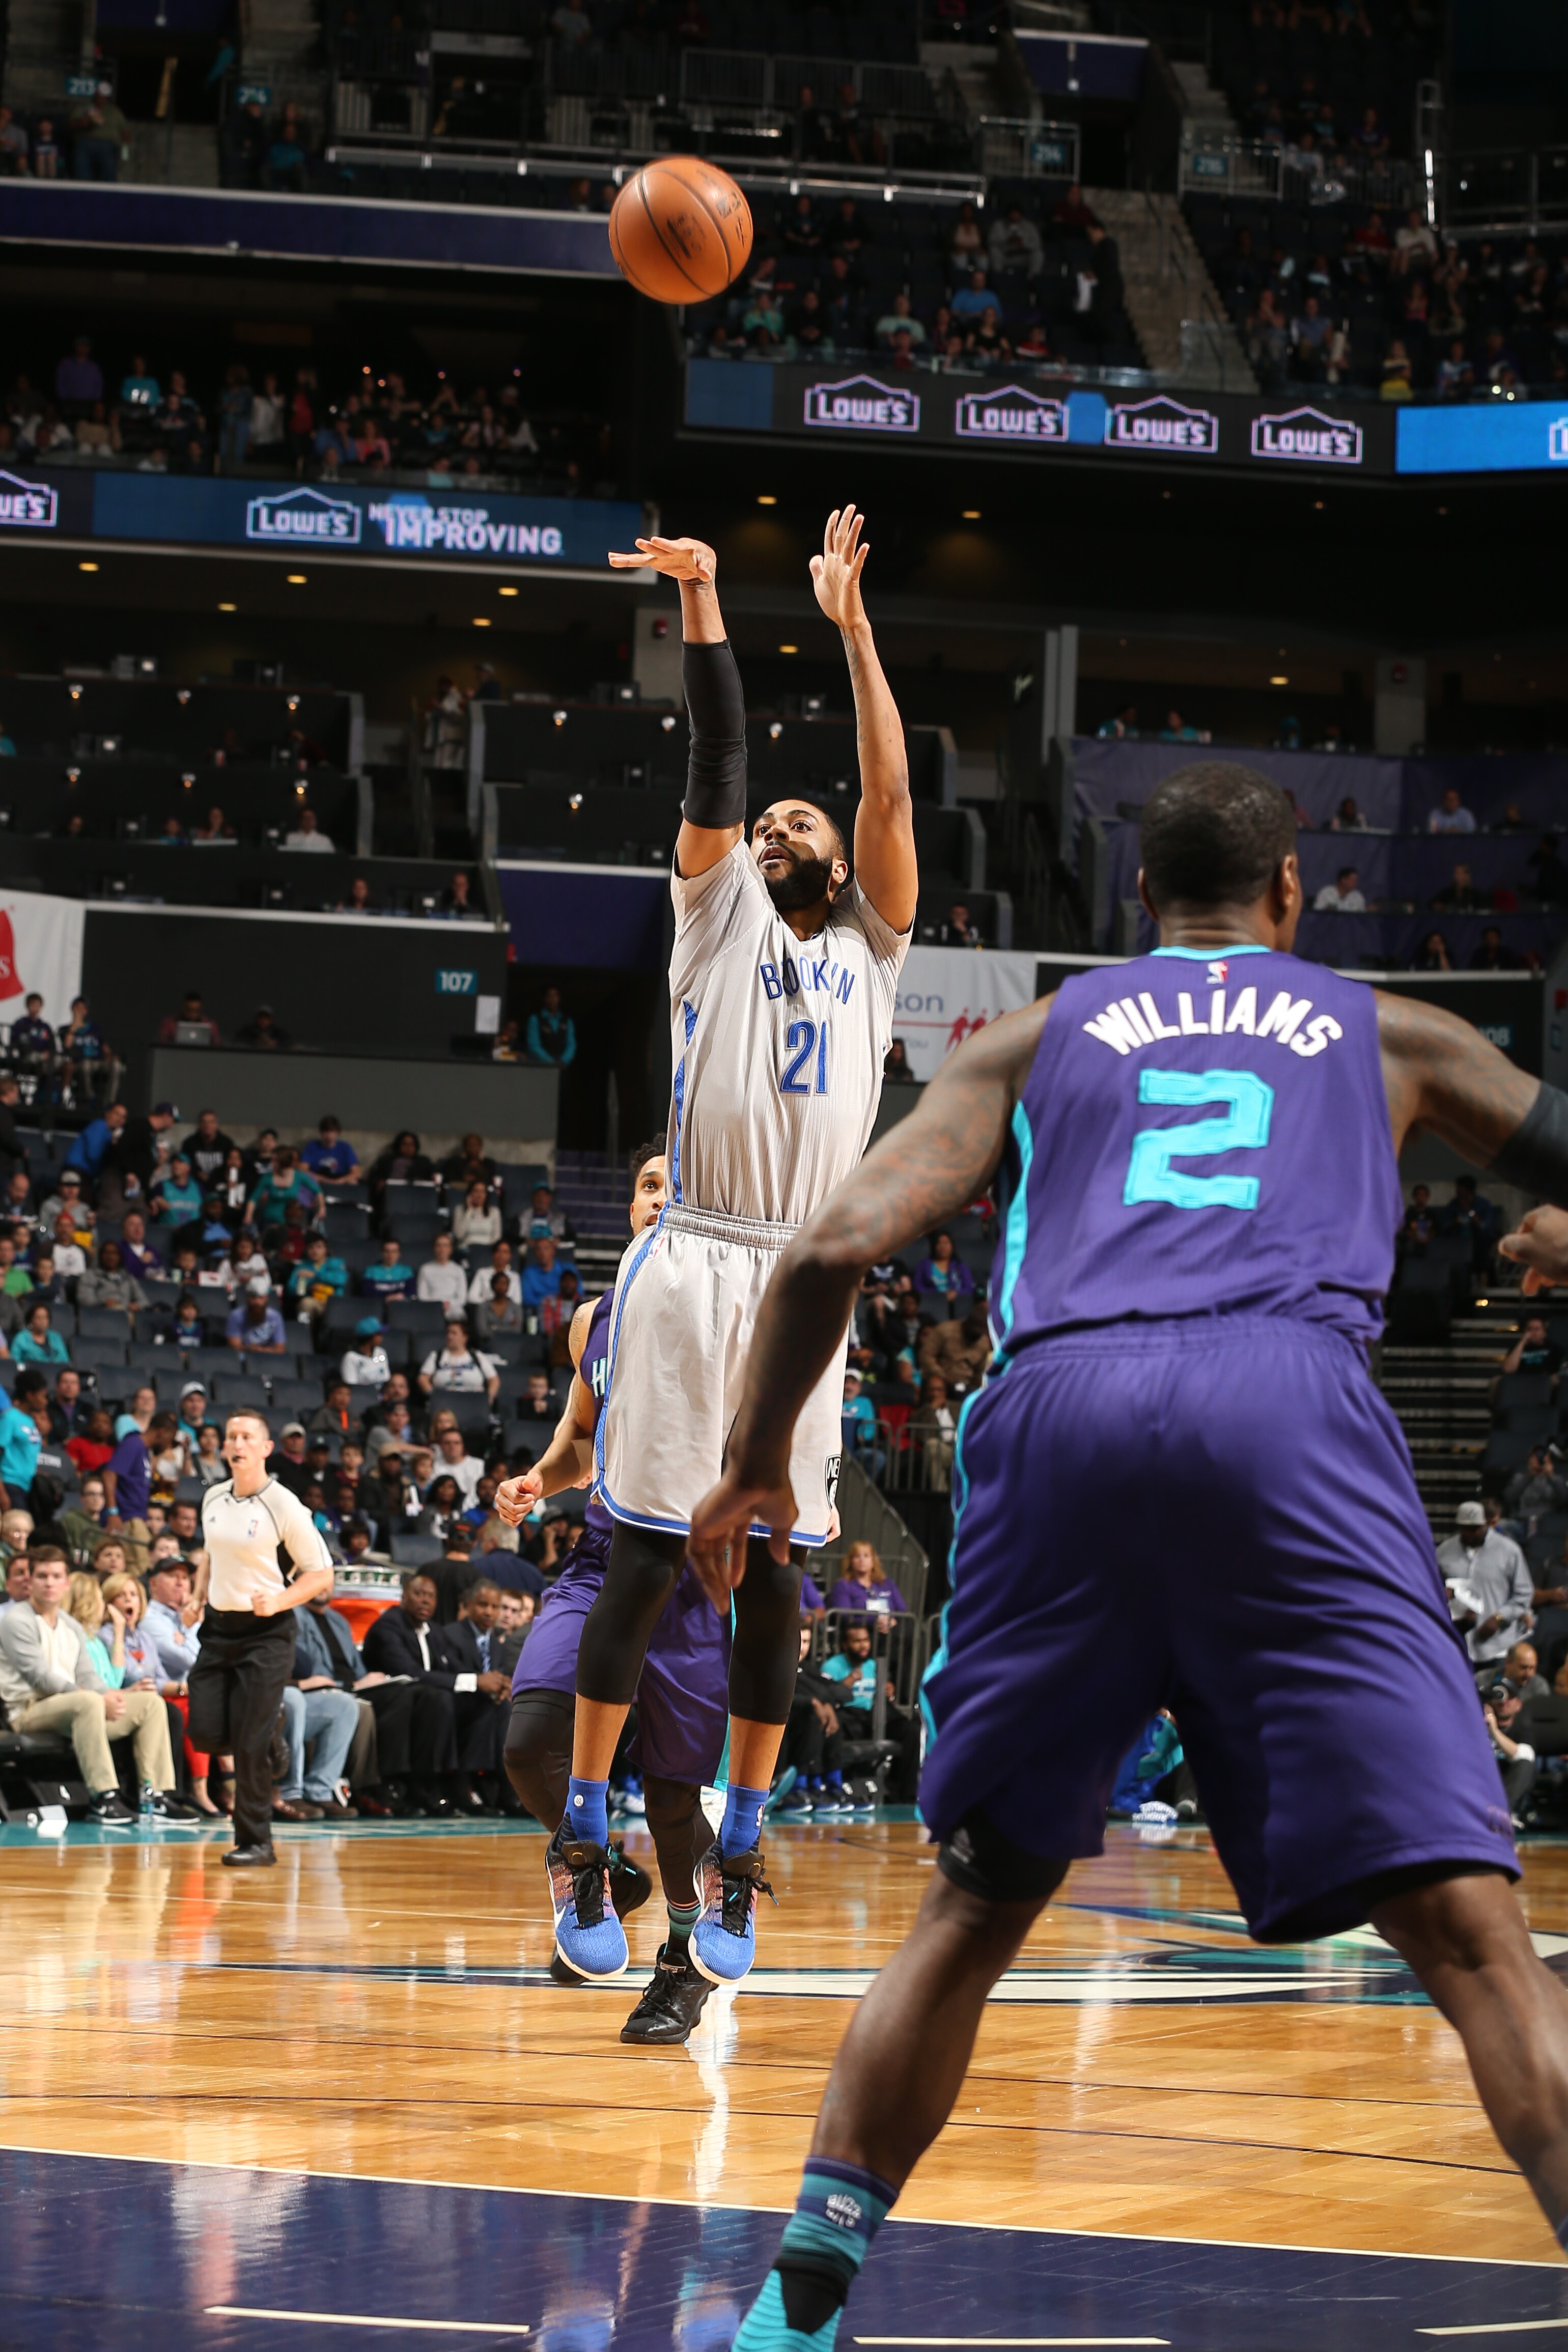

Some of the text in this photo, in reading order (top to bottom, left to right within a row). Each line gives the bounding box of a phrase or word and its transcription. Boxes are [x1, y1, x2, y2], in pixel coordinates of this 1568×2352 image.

[385, 517, 562, 555] IMPROVING
[436, 507, 489, 525] STOP
[440, 971, 473, 992] 107
[1082, 986, 1344, 1057] WILLIAMS
[780, 1019, 828, 1095] 21
[1123, 1068, 1275, 1210] 2
